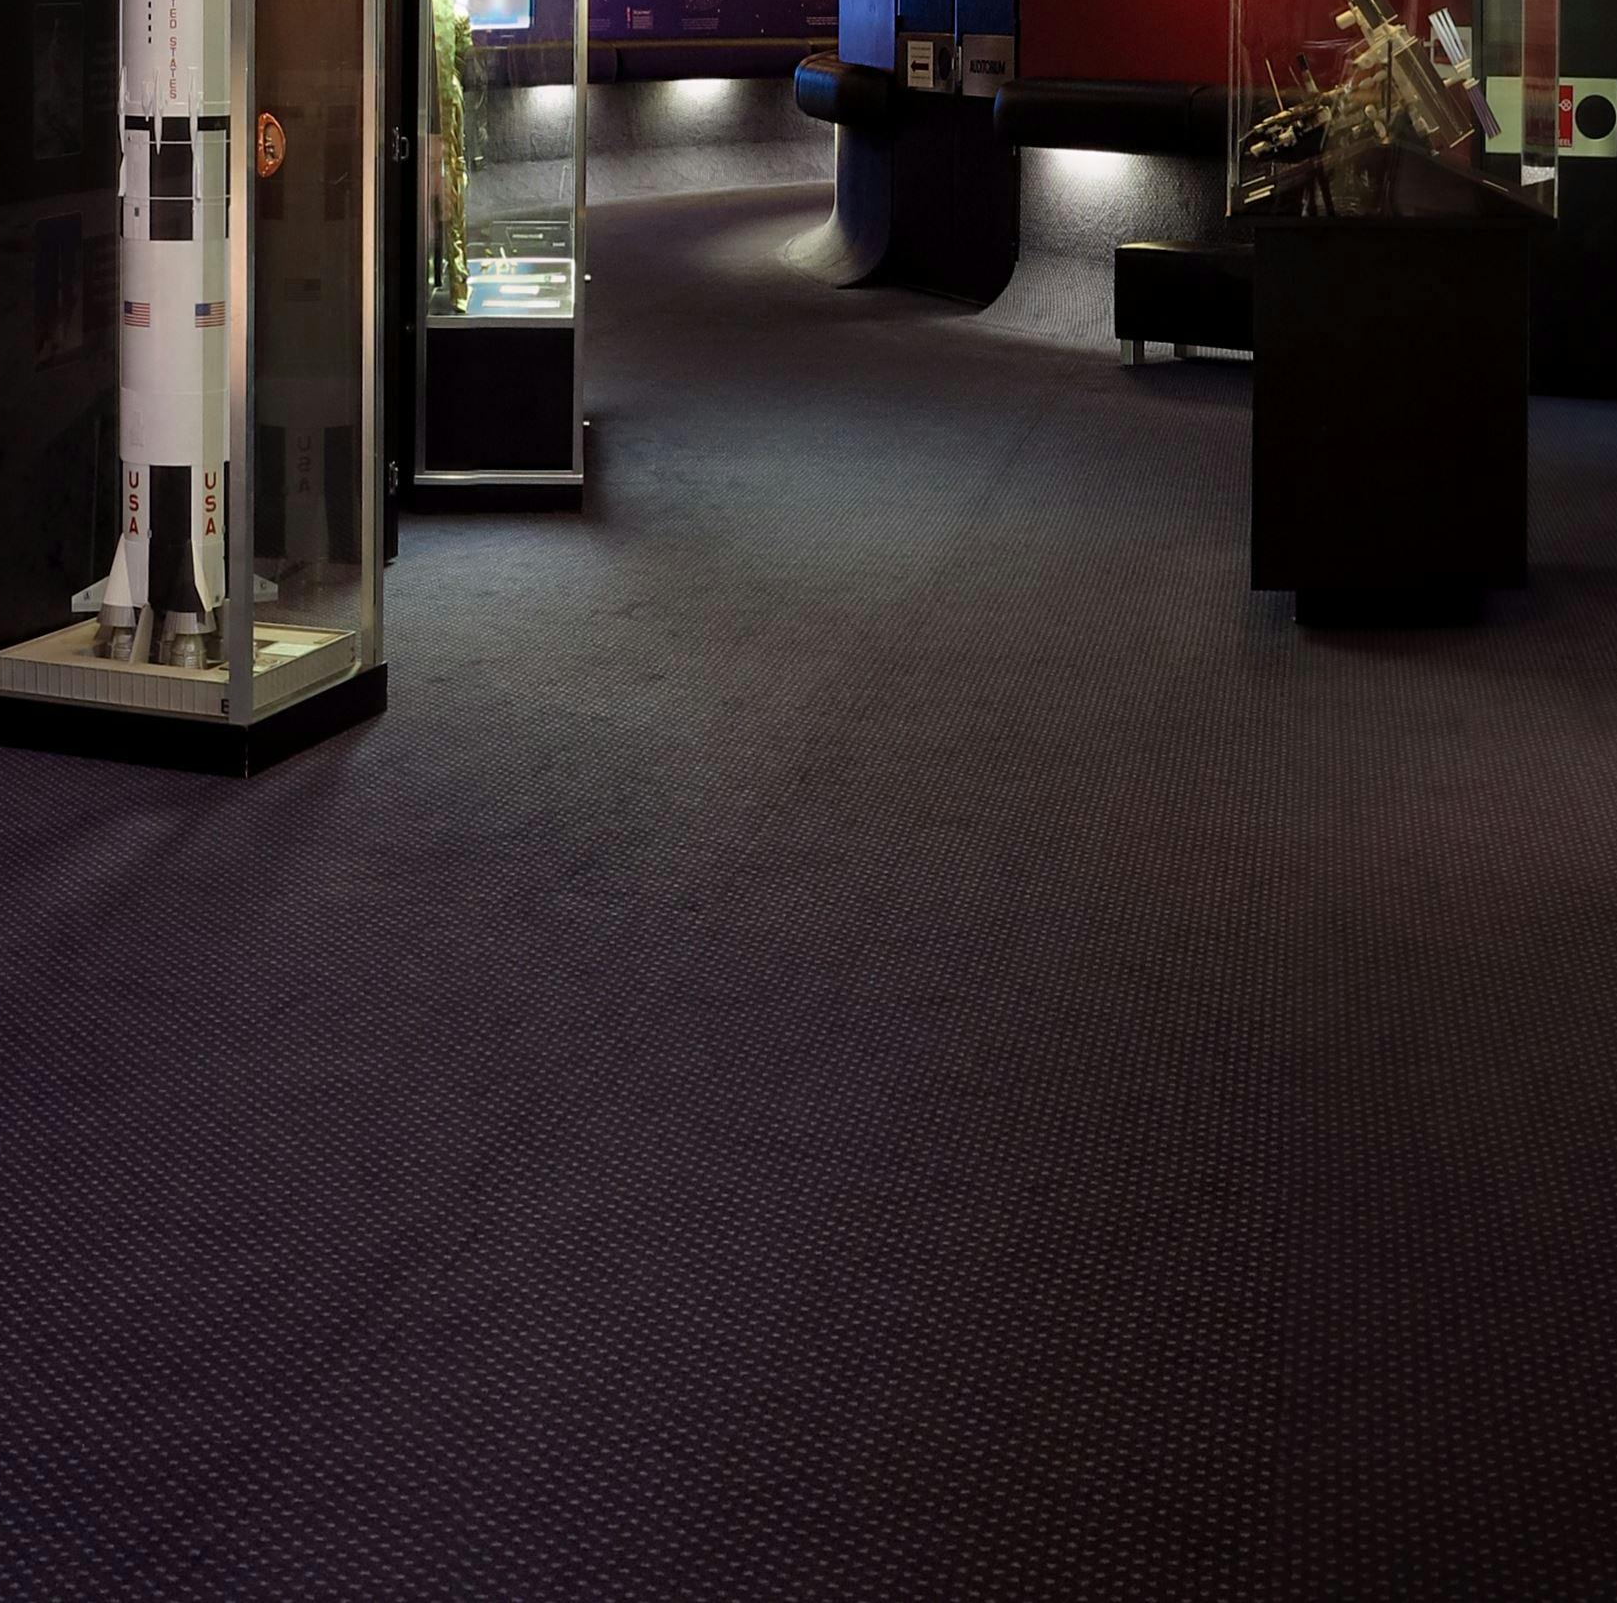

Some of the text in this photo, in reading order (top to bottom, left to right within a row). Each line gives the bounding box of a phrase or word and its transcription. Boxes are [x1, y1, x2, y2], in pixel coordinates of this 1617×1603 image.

[169, 37, 177, 99] STATES
[128, 471, 139, 535] USA
[205, 472, 217, 535] USA
